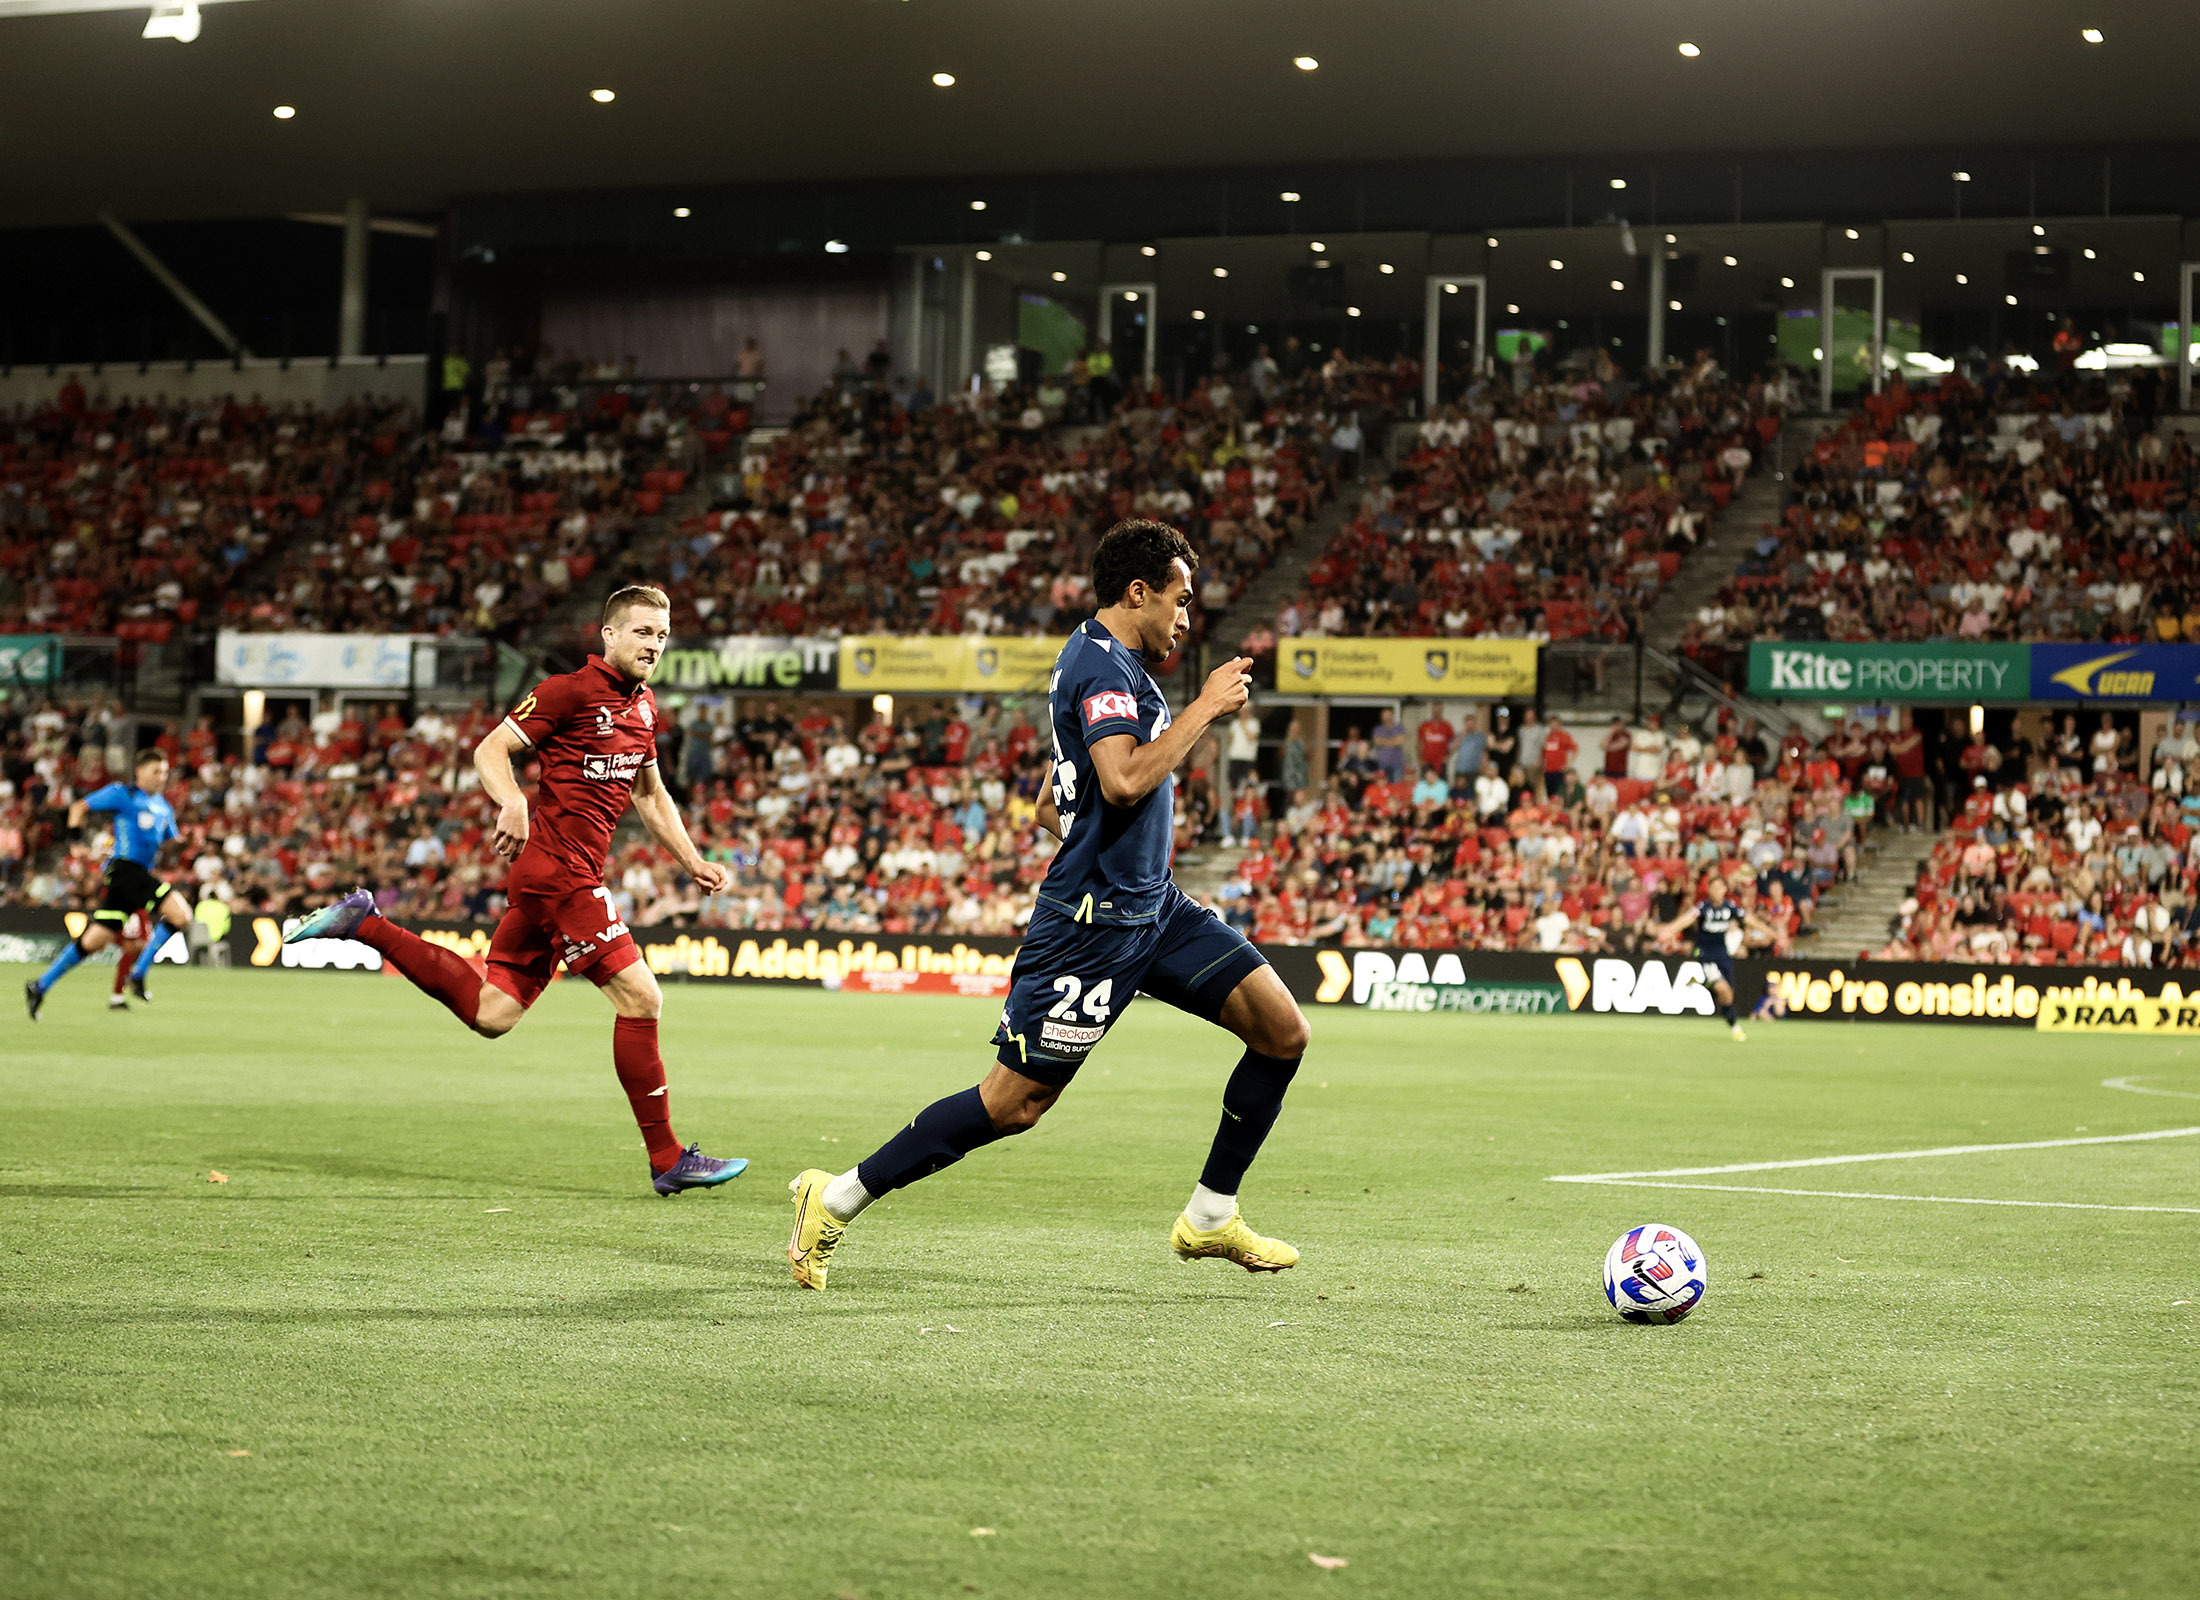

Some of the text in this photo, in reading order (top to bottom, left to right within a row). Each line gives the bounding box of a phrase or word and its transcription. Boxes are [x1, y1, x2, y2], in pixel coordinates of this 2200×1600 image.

[1322, 650, 1378, 664] Flinders
[1454, 650, 1512, 664] Flinders
[1770, 650, 2010, 692] Kite PROPERTY
[1322, 667, 1396, 683] University
[1454, 667, 1529, 683] University
[592, 886, 617, 921] 7
[645, 934, 730, 977] with
[731, 938, 899, 980] Adelaide
[1048, 975, 1113, 1024] 24
[1438, 986, 1562, 1014] PROPERTY
[1592, 958, 1716, 1016] RAA
[1766, 969, 1889, 1015] We're
[1895, 972, 2040, 1019] onside
[2074, 1007, 2138, 1026] RAA
[1040, 1039, 1071, 1053] building
